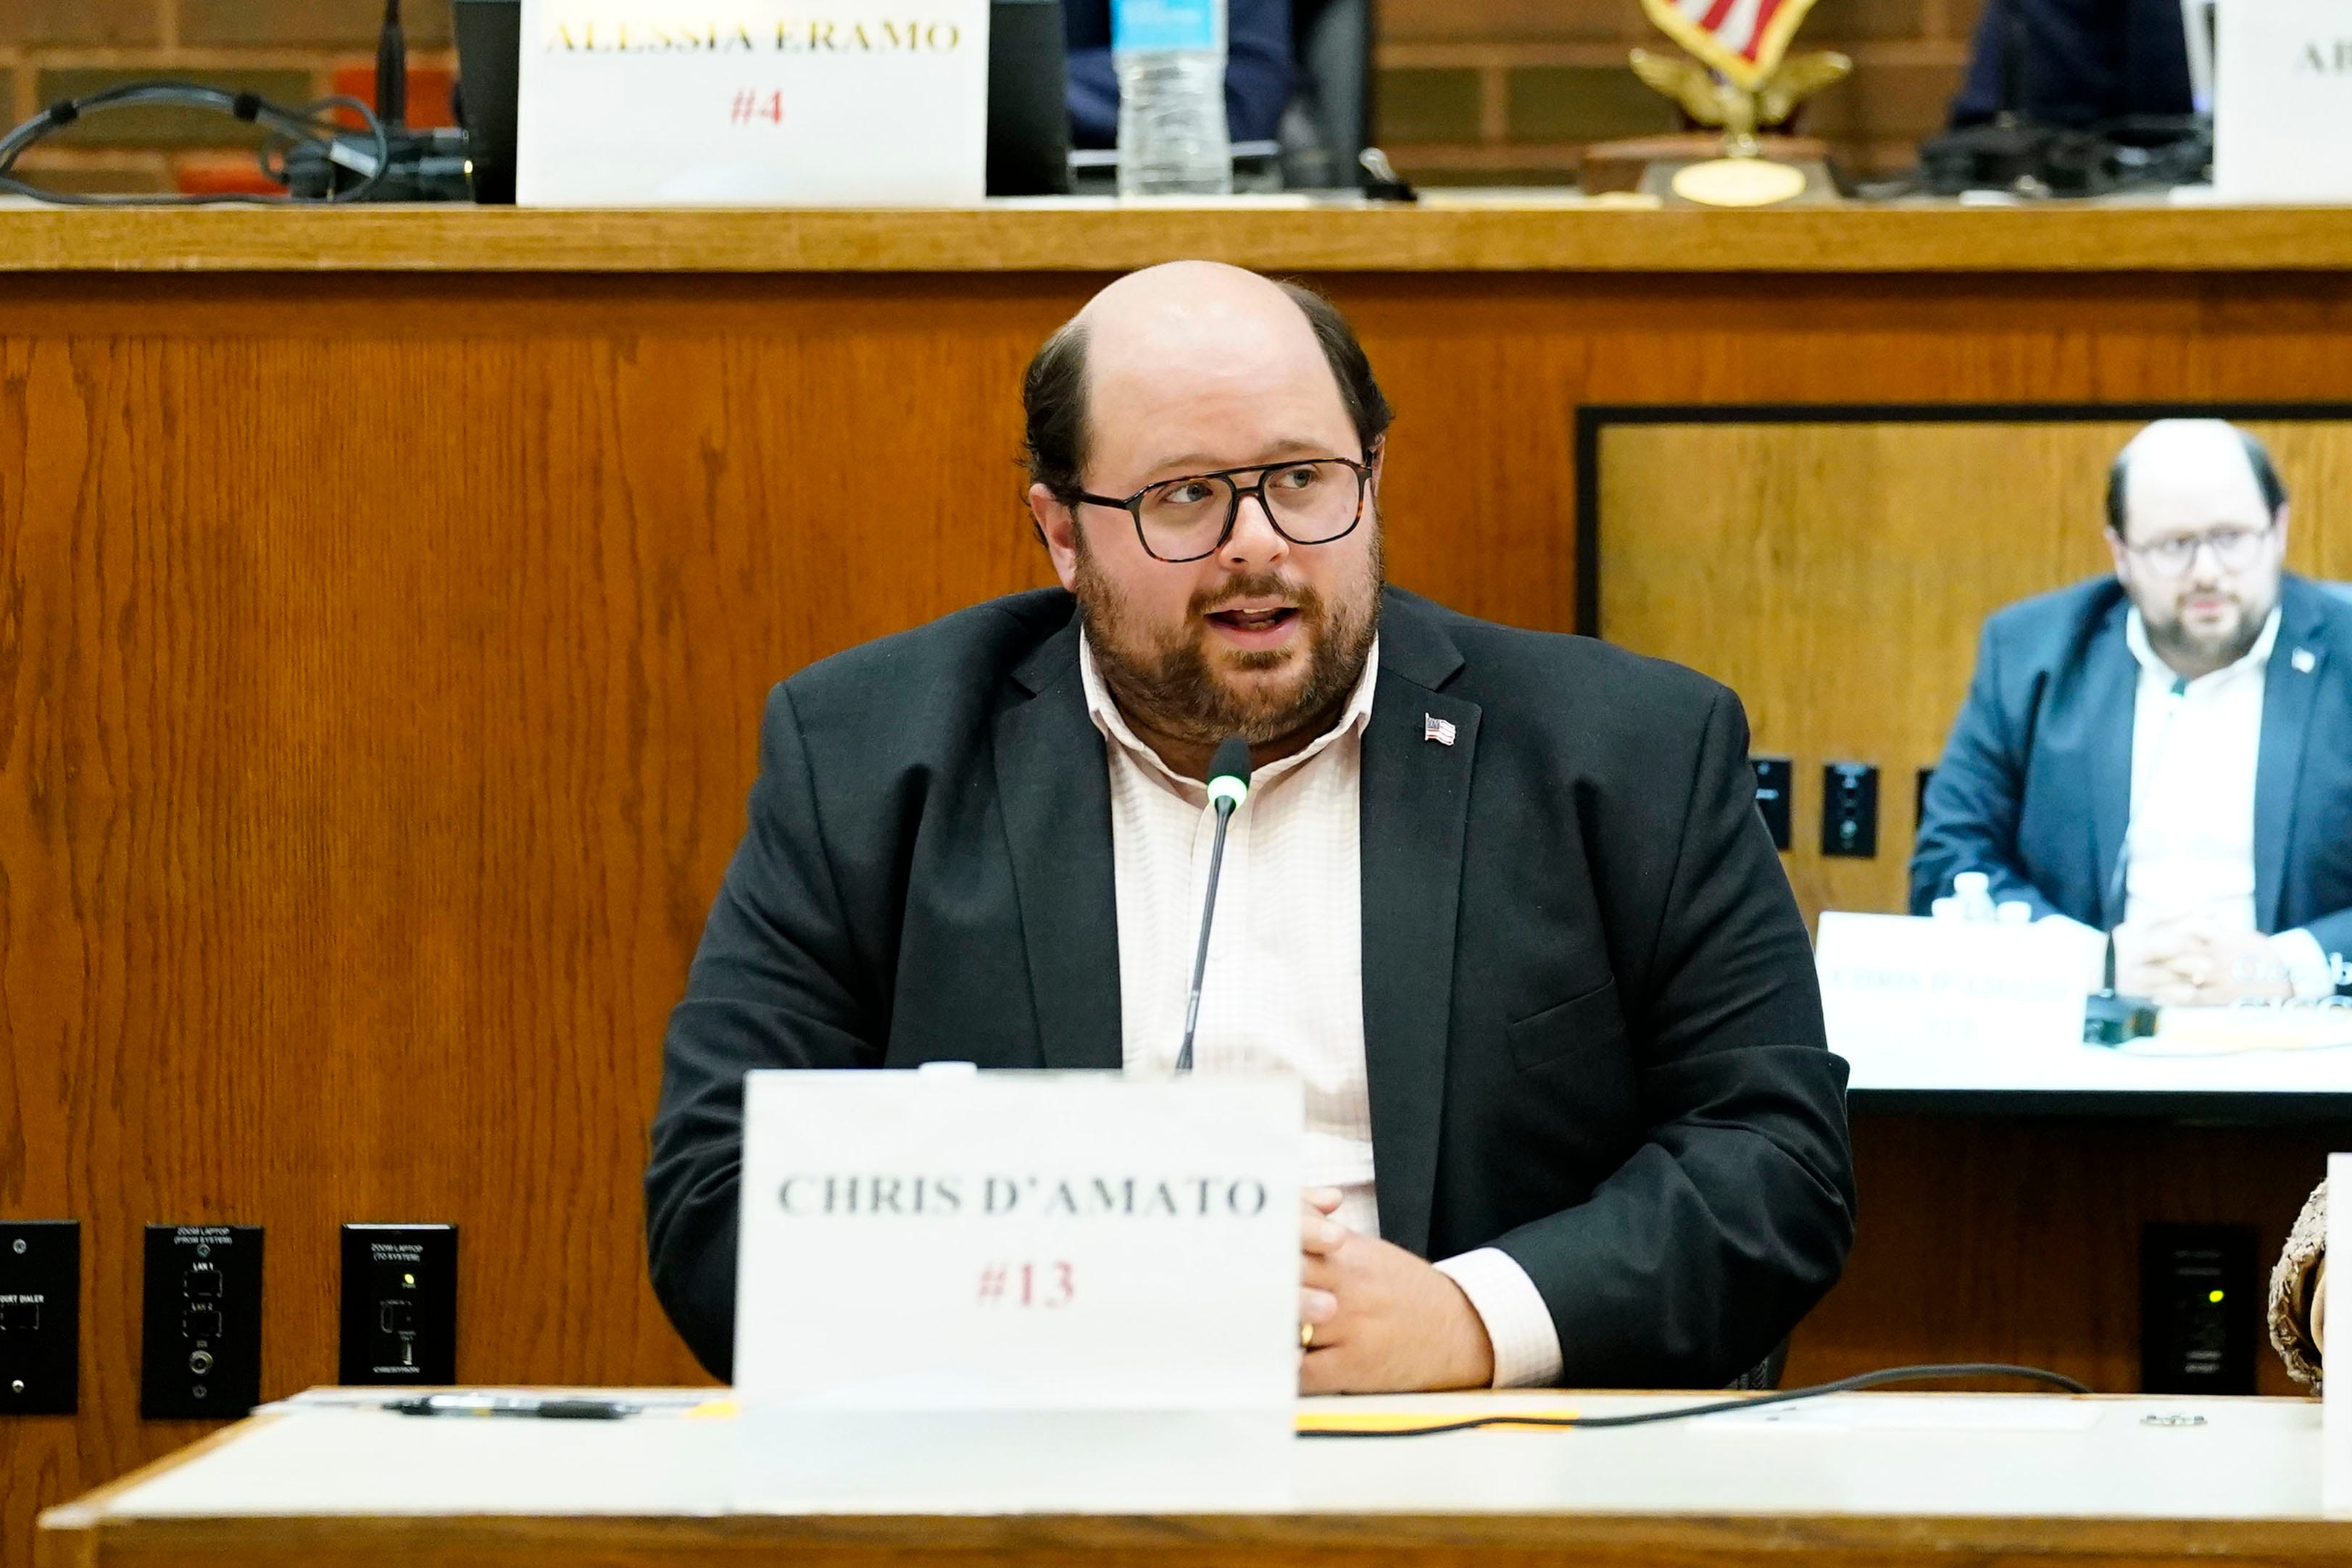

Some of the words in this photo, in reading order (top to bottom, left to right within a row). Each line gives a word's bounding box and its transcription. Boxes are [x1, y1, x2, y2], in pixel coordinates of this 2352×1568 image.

[544, 20, 754, 54] ALESSIA
[773, 18, 963, 53] ERAMO
[730, 87, 784, 125] #4
[777, 1175, 963, 1215] CHRIS
[982, 1175, 1268, 1217] D'AMATO
[978, 1261, 1074, 1307] #13
